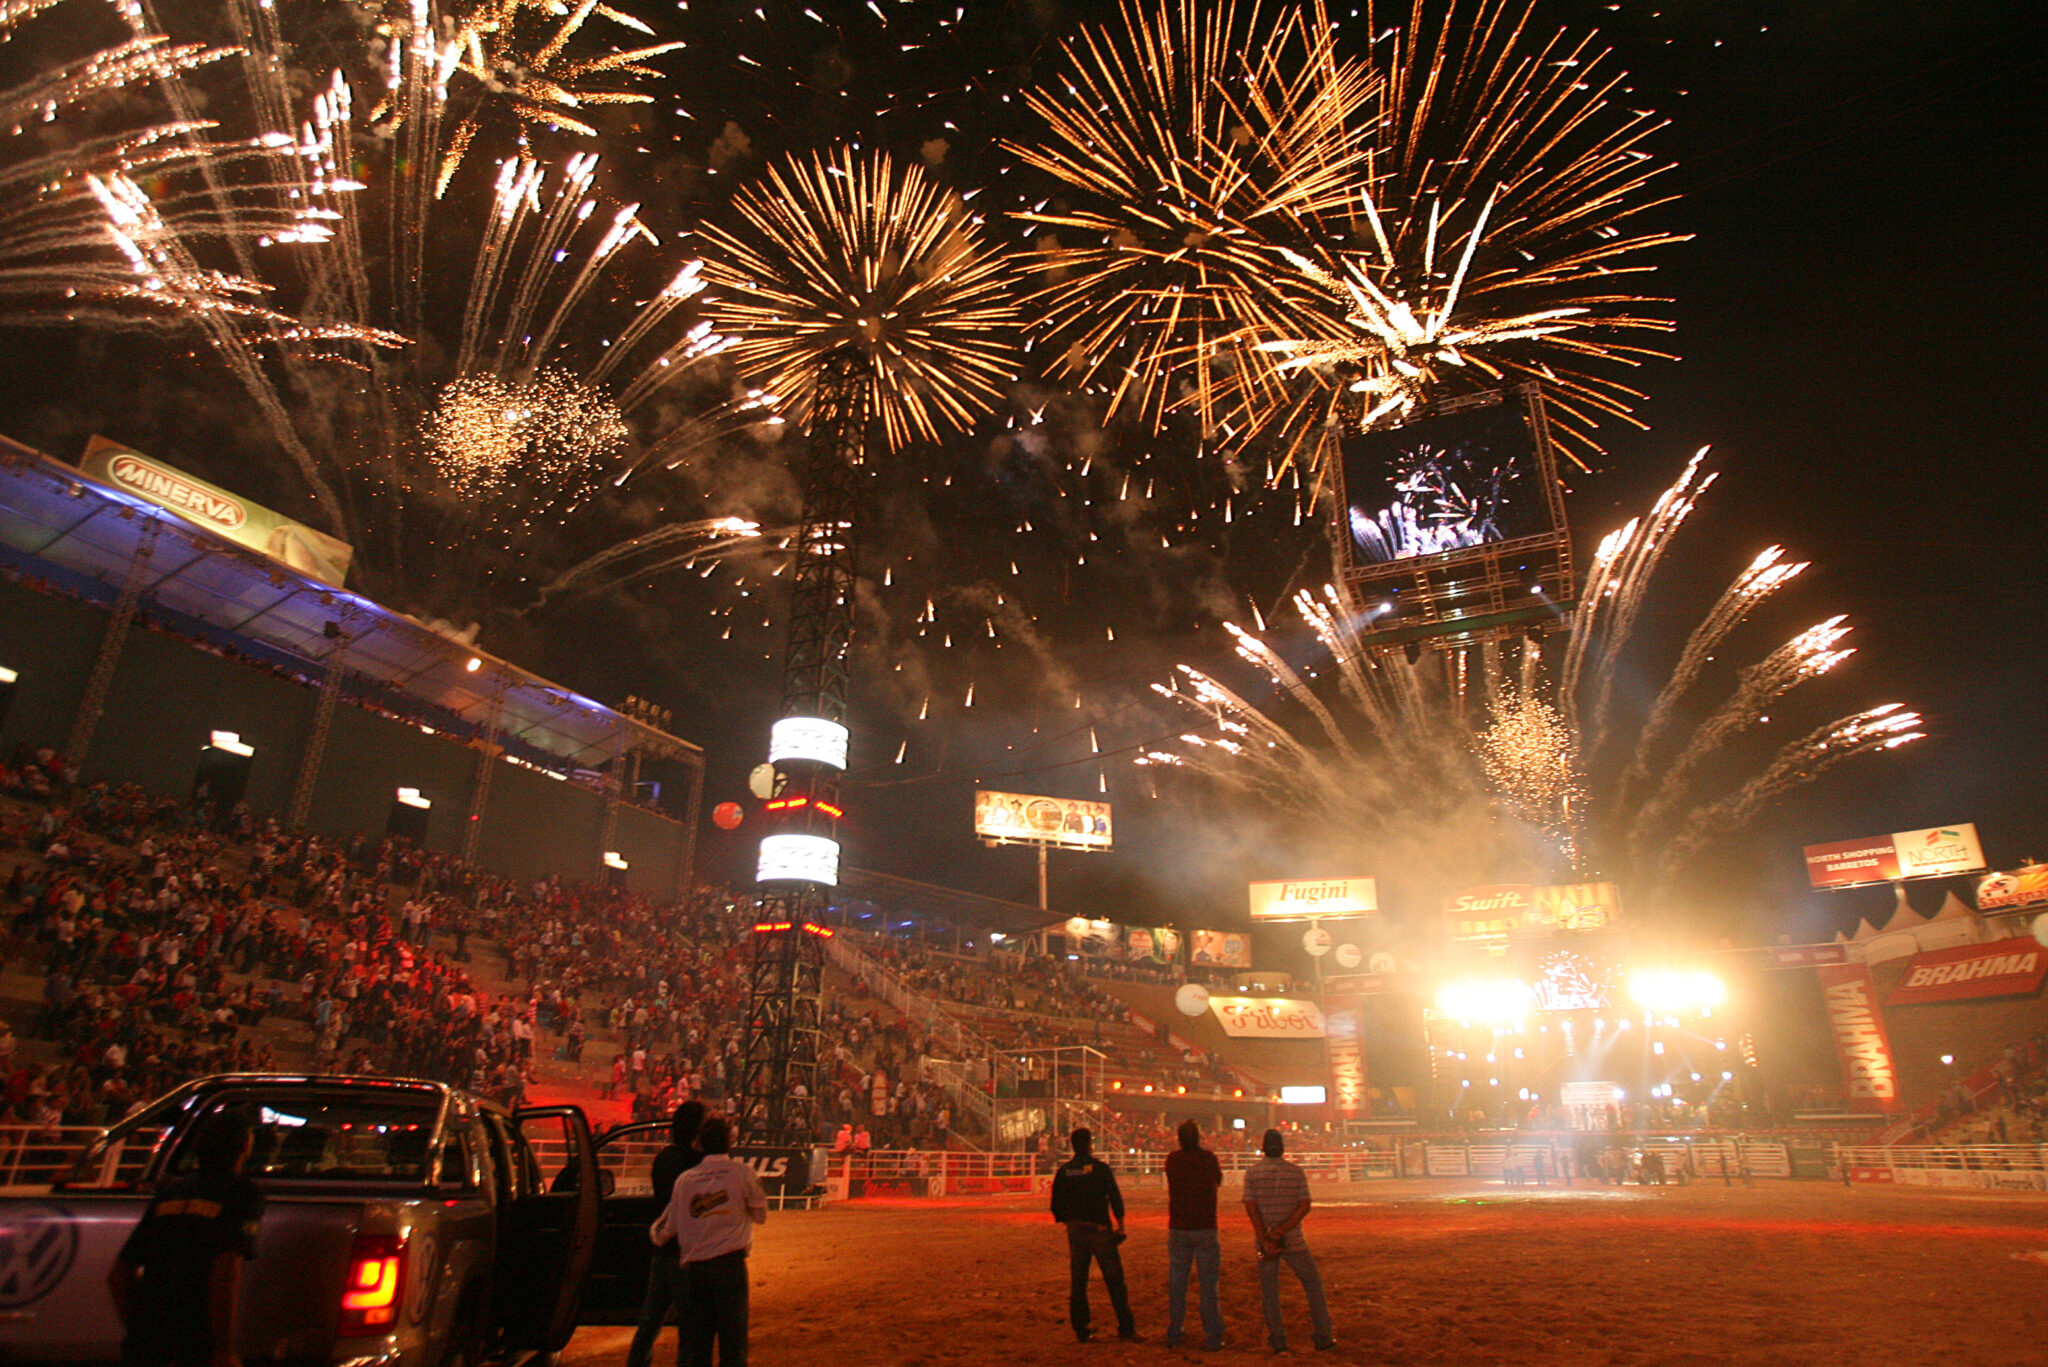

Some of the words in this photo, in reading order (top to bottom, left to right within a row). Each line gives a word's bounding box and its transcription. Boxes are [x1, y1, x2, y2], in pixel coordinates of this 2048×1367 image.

[117, 464, 237, 524] MINERVA
[1806, 852, 1841, 864] NORTH
[1842, 846, 1895, 860] SHOPPING
[1908, 844, 1968, 863] NORTH
[1826, 858, 1879, 872] BARRETOS
[1277, 881, 1348, 905] Fugini
[1447, 891, 1529, 912] Swift
[1906, 952, 2039, 987] BRAHMA
[1827, 979, 1895, 1099] BRAHMA
